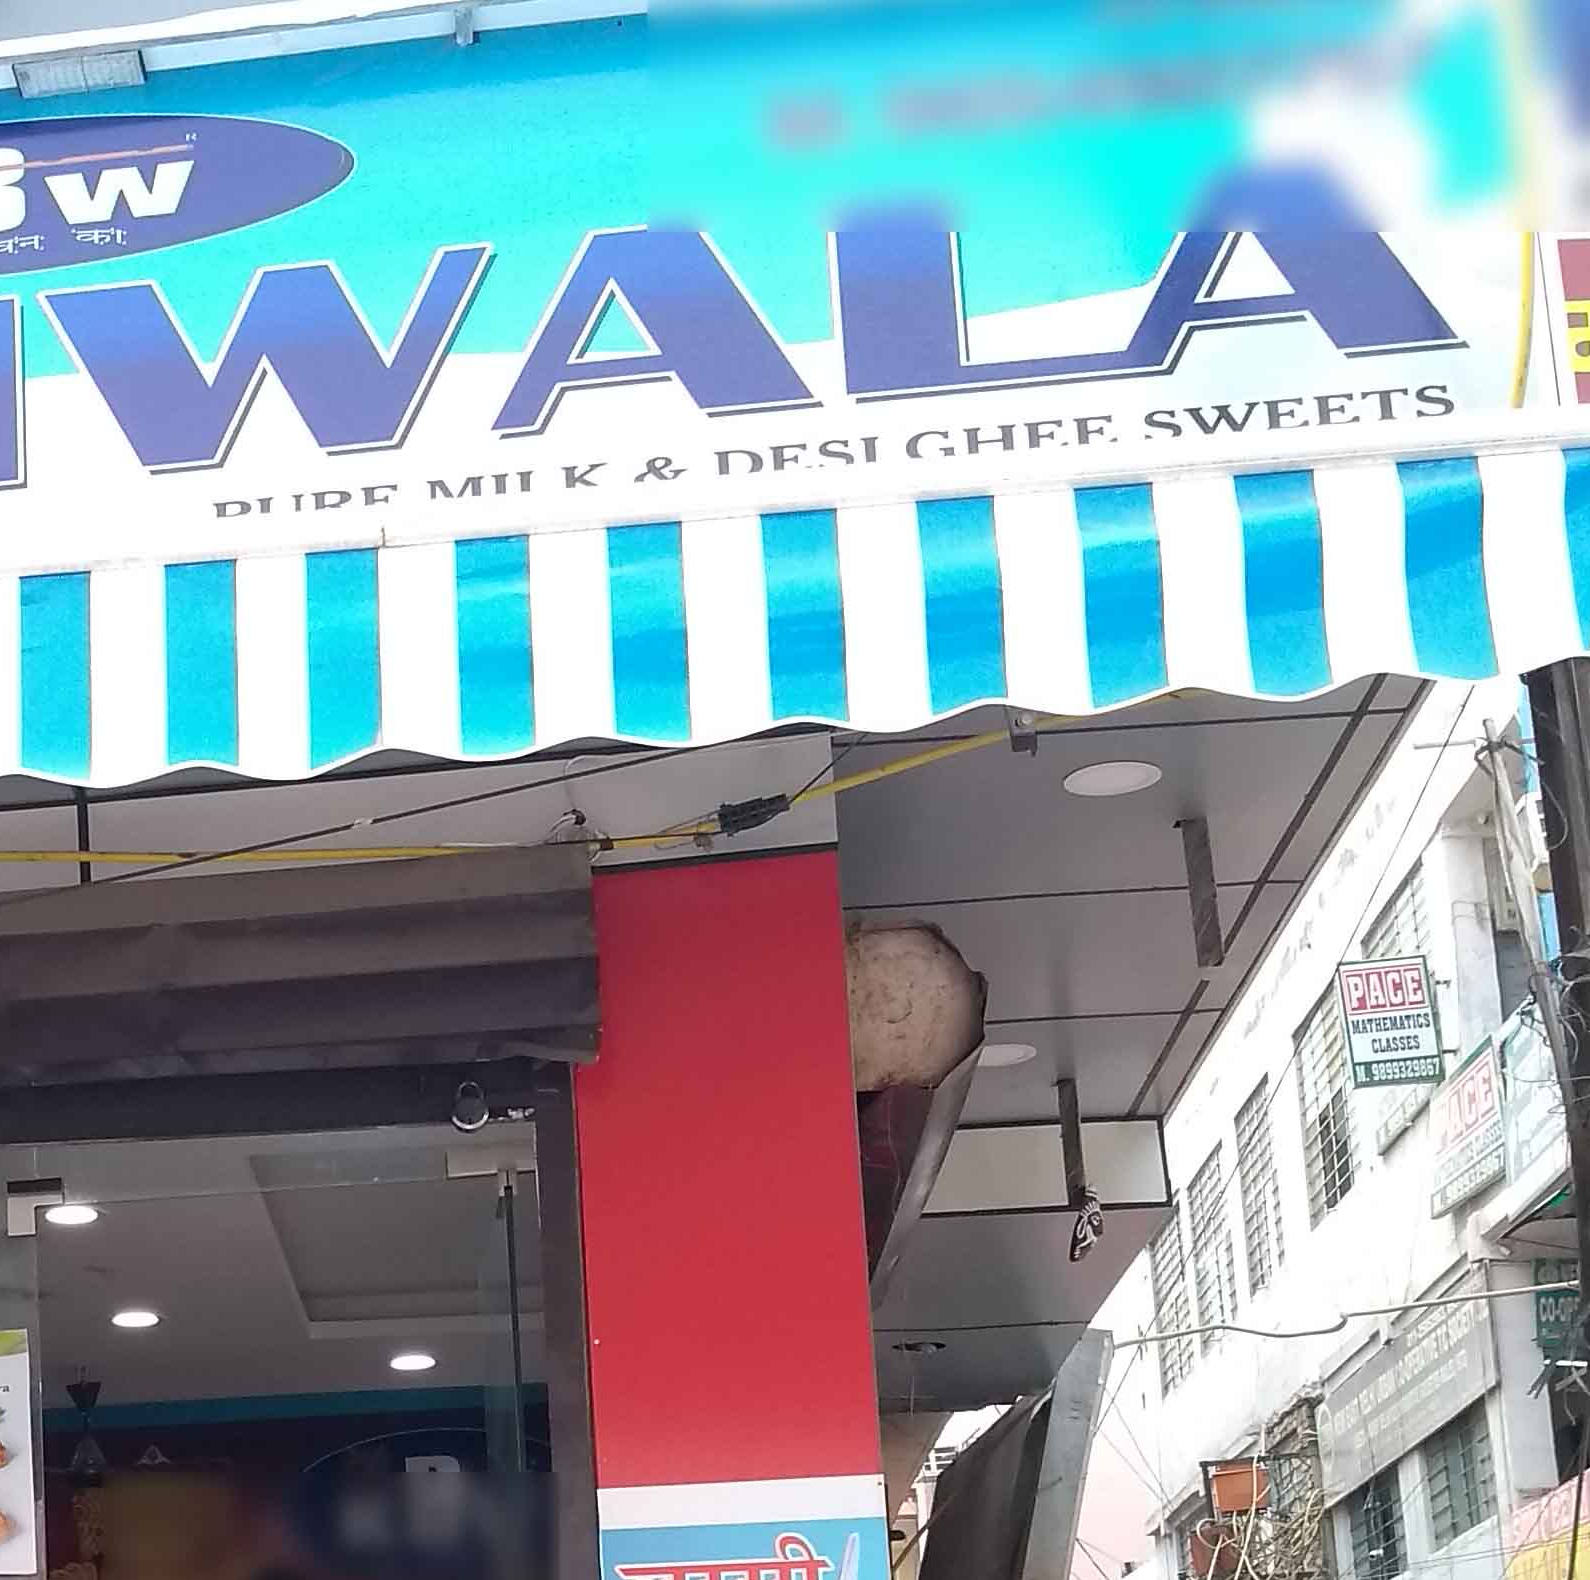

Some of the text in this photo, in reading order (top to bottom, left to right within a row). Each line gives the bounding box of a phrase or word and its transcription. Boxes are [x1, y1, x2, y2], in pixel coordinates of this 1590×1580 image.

[634, 455, 688, 482] &
[1143, 383, 1456, 440] SWEETS
[1346, 968, 1425, 1008] PACE
[1351, 1013, 1430, 1035] MATHEMATICS
[1371, 1034, 1421, 1054] CLASSES
